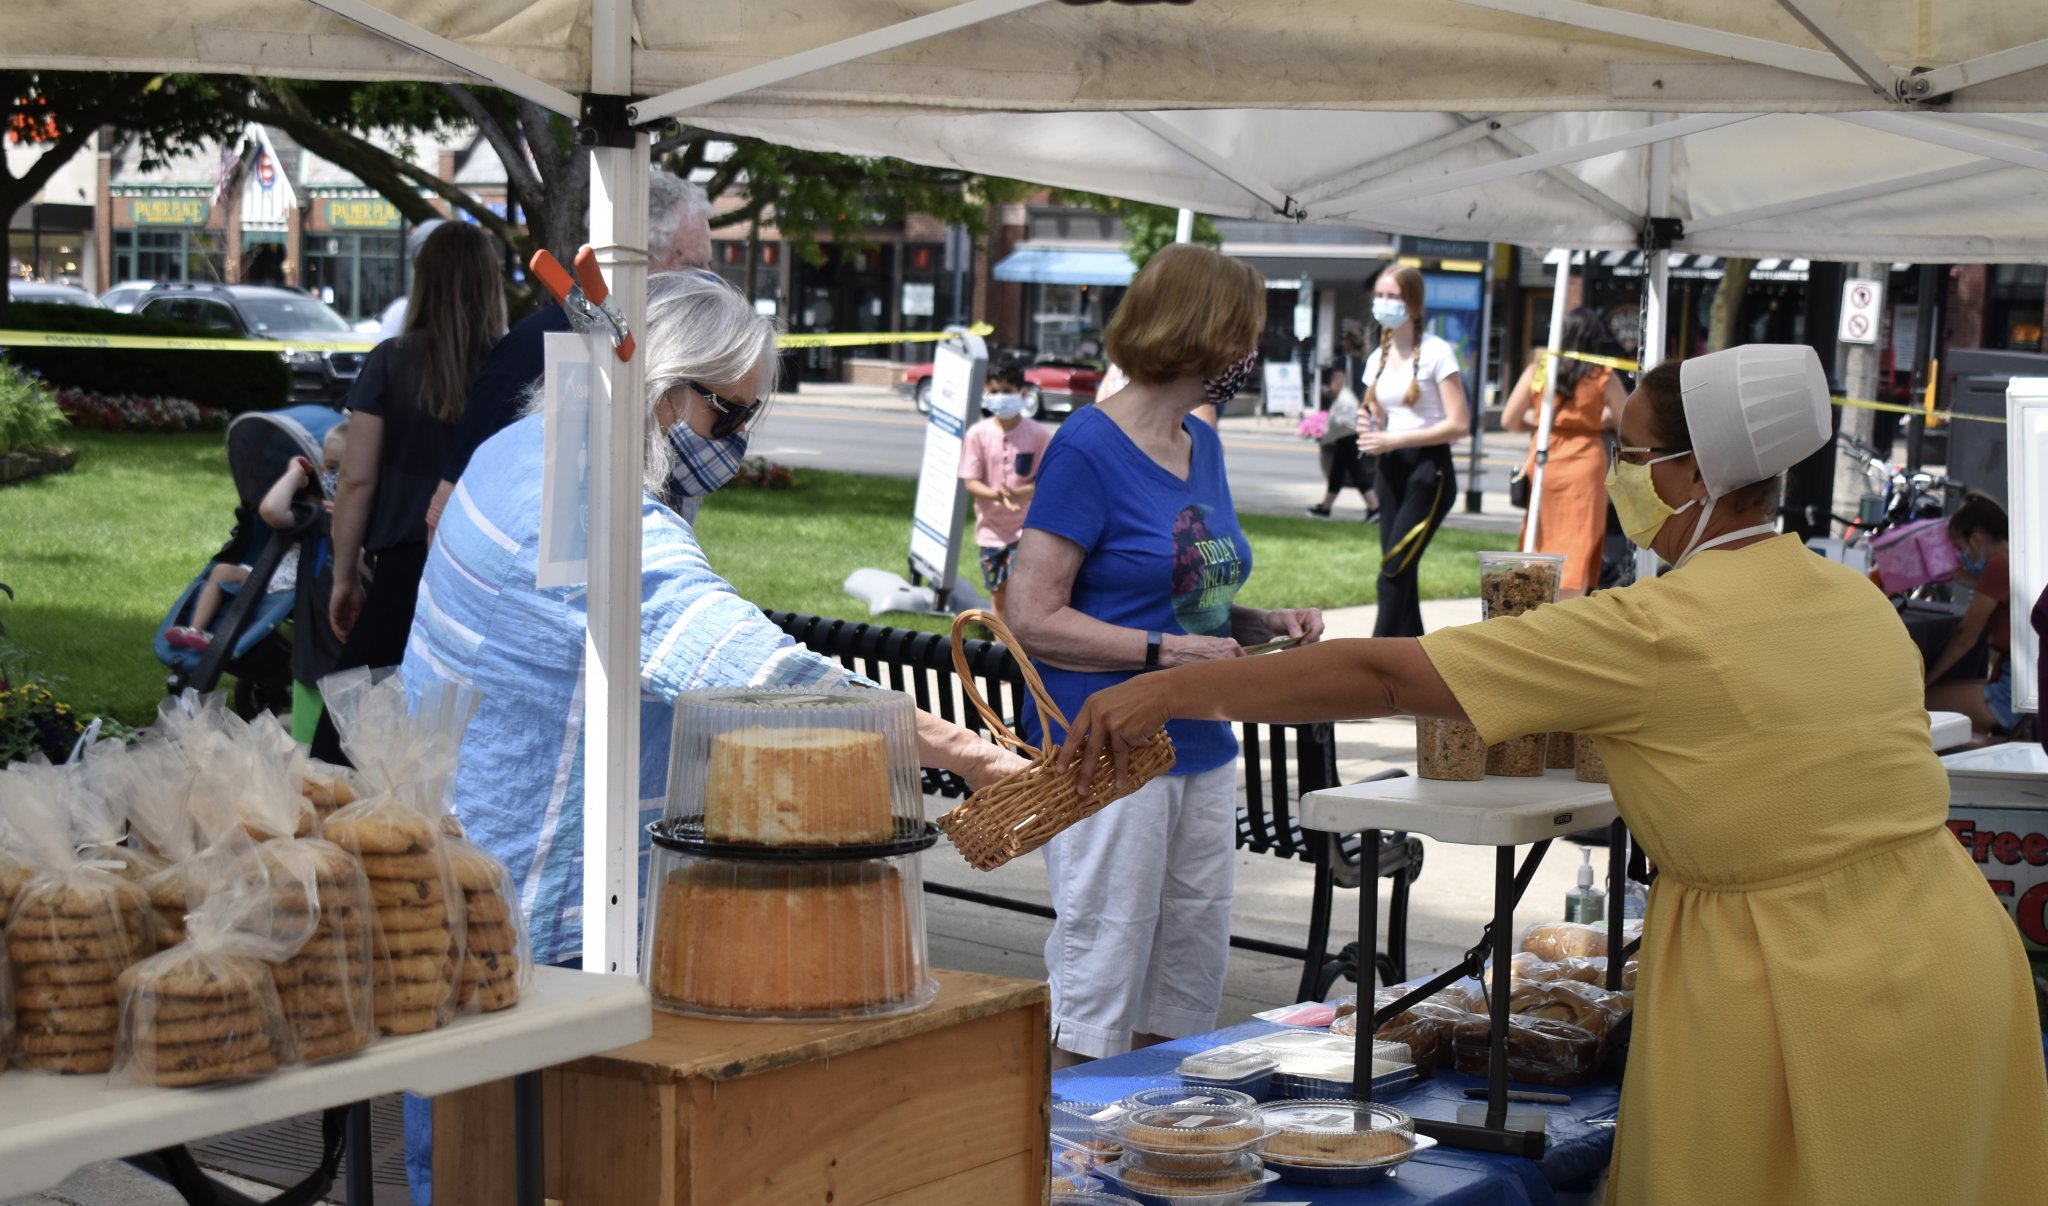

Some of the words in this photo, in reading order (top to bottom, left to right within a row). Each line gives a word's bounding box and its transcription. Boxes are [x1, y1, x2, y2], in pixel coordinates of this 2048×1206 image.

[134, 200, 169, 223] PALMER
[172, 200, 202, 223] PLACE
[331, 202, 370, 225] PALMER
[374, 202, 401, 220] PLAC
[1195, 536, 1238, 566] TODAY
[1204, 565, 1225, 589] WILL
[1229, 561, 1242, 584] BE
[1945, 819, 2048, 867] Free
